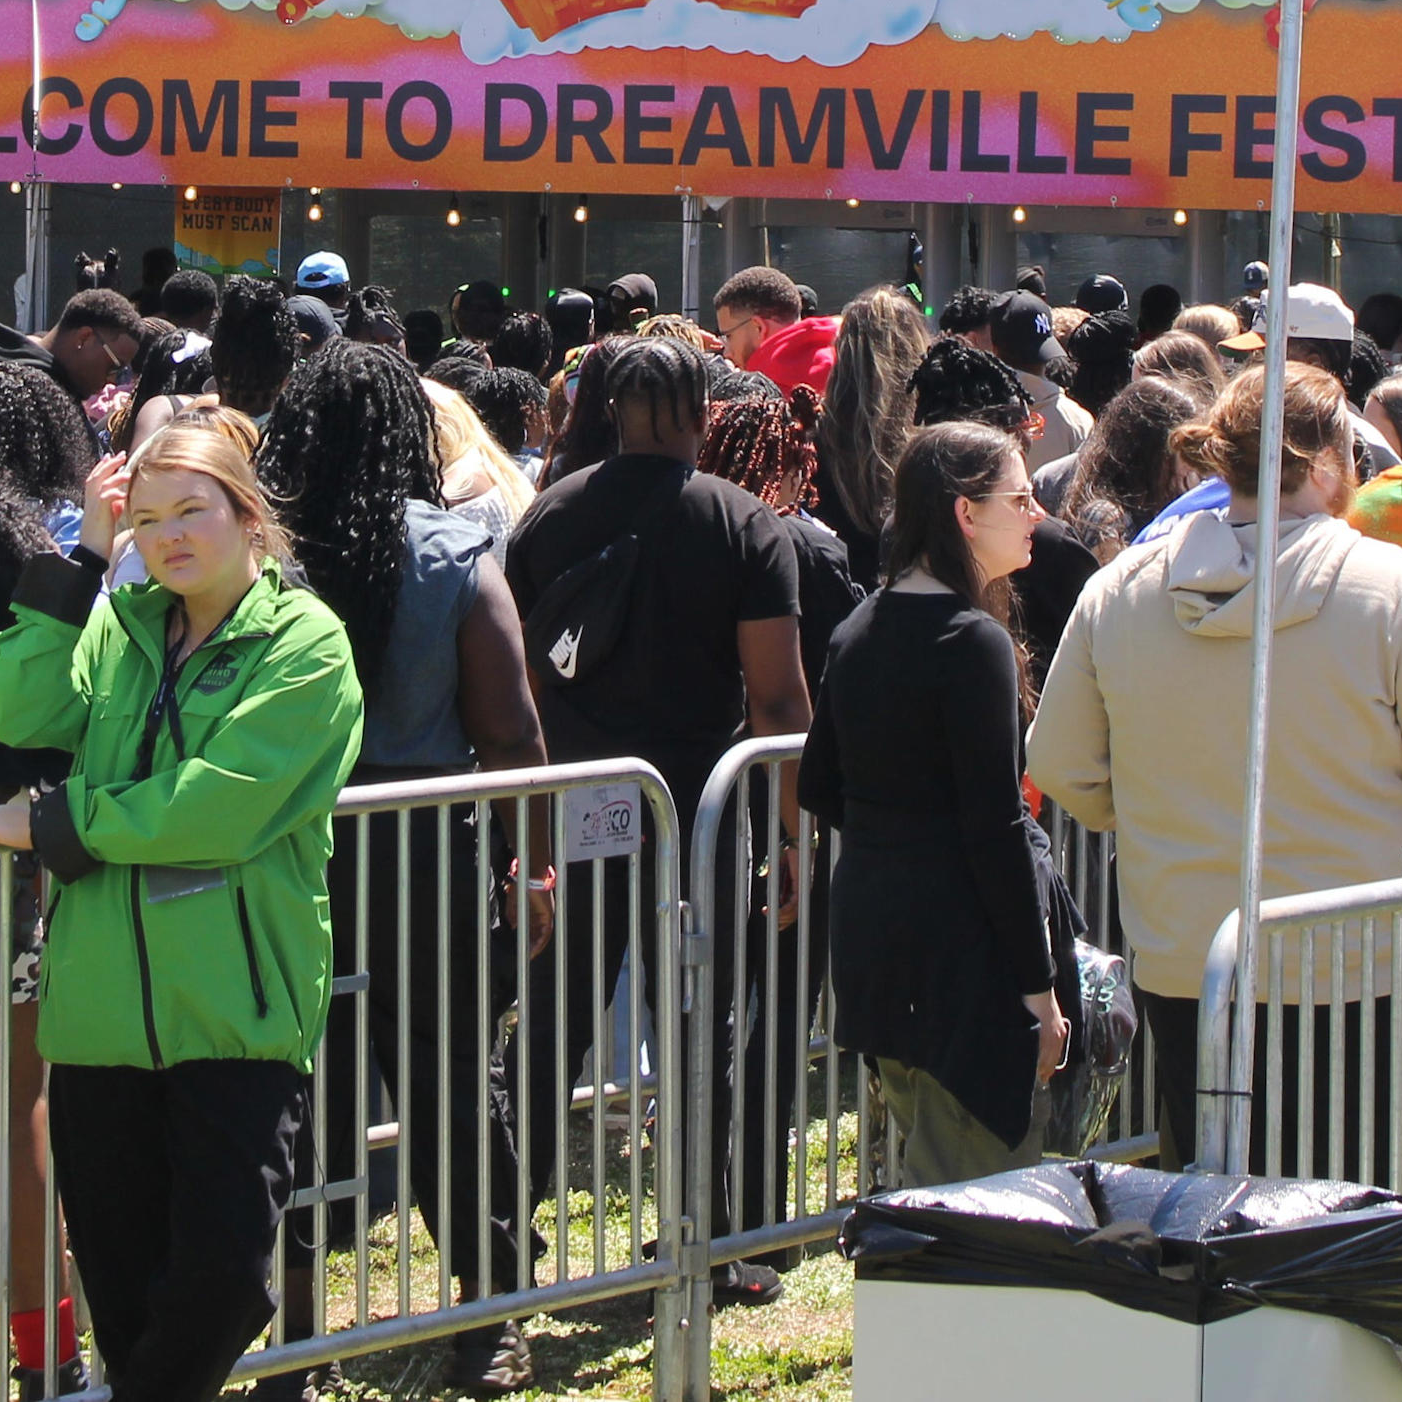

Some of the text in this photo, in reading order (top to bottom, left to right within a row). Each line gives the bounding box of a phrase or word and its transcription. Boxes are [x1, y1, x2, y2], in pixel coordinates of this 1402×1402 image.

[330, 80, 453, 161] TO
[484, 83, 1134, 174] DREAMVILLE
[182, 214, 274, 232] MUST SCAN
[1034, 312, 1051, 334] NY
